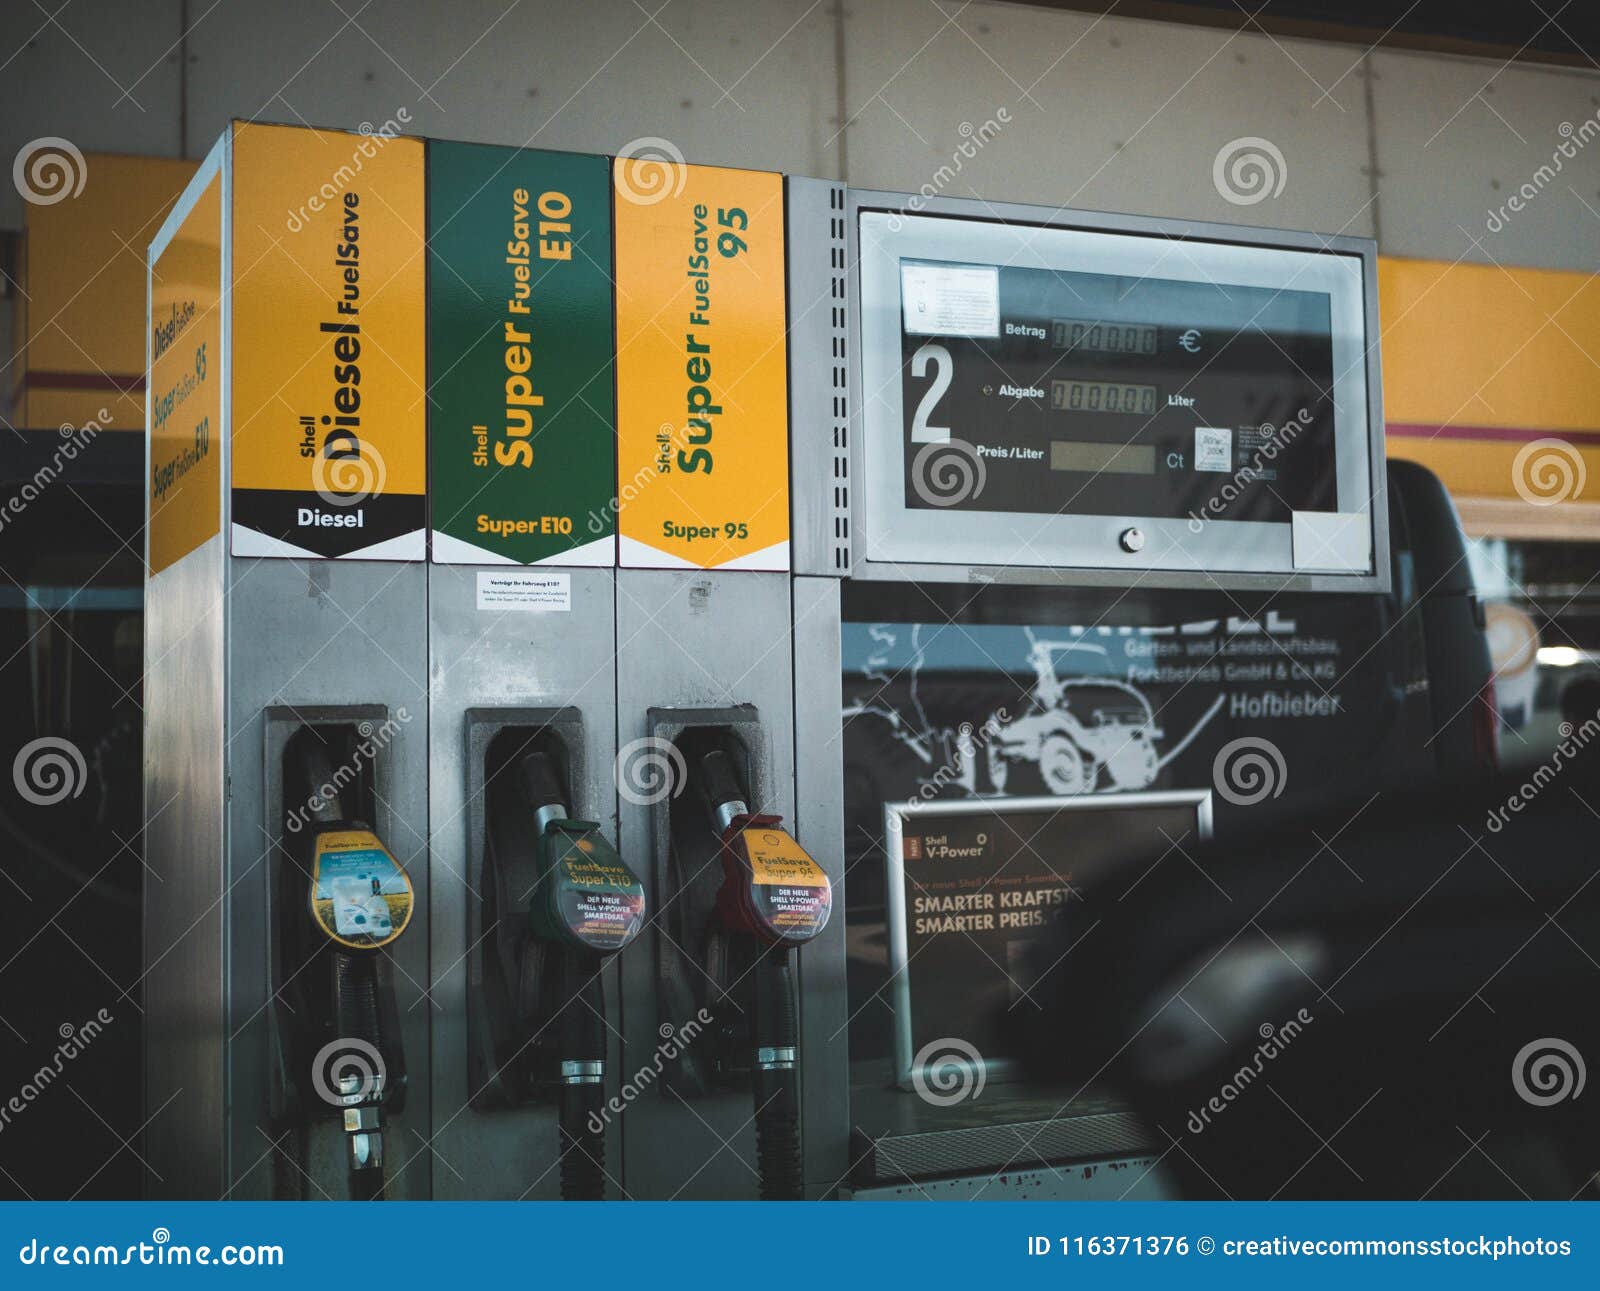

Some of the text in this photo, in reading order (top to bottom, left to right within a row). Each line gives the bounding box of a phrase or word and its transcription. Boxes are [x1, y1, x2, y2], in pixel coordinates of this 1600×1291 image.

[537, 191, 573, 261] E10
[718, 207, 748, 259] 95
[154, 302, 176, 361] Diesel
[321, 192, 361, 461] Diesel FuelSave
[493, 188, 544, 469] Super FuelSave
[1005, 323, 1047, 339] Betrag
[677, 204, 723, 475] Super FuelSave
[1179, 329, 1201, 352] €
[154, 387, 176, 431] Super
[196, 341, 207, 383] 95
[911, 344, 954, 445] 2
[999, 385, 1045, 399] Abgabe
[1168, 394, 1195, 407] Liter
[301, 416, 316, 458] Shell
[473, 425, 488, 466] Shell
[153, 462, 175, 501] Super
[195, 416, 209, 463] E10
[656, 434, 671, 473] Shell
[1166, 453, 1184, 469] Ct
[298, 509, 364, 528] Diesel
[476, 514, 572, 538] Super E10
[663, 520, 748, 542] Super 95
[1187, 639, 1217, 656] und
[1225, 662, 1272, 680] GmbH
[1230, 691, 1341, 718] Hofbieber
[925, 835, 947, 846] Shell
[926, 846, 983, 859] V-Power
[570, 872, 631, 888] Super E10
[765, 866, 815, 879] Super 95
[914, 894, 994, 914] SMARTER
[915, 914, 994, 934] SMARTER
[1001, 910, 1047, 928] PREIS.
